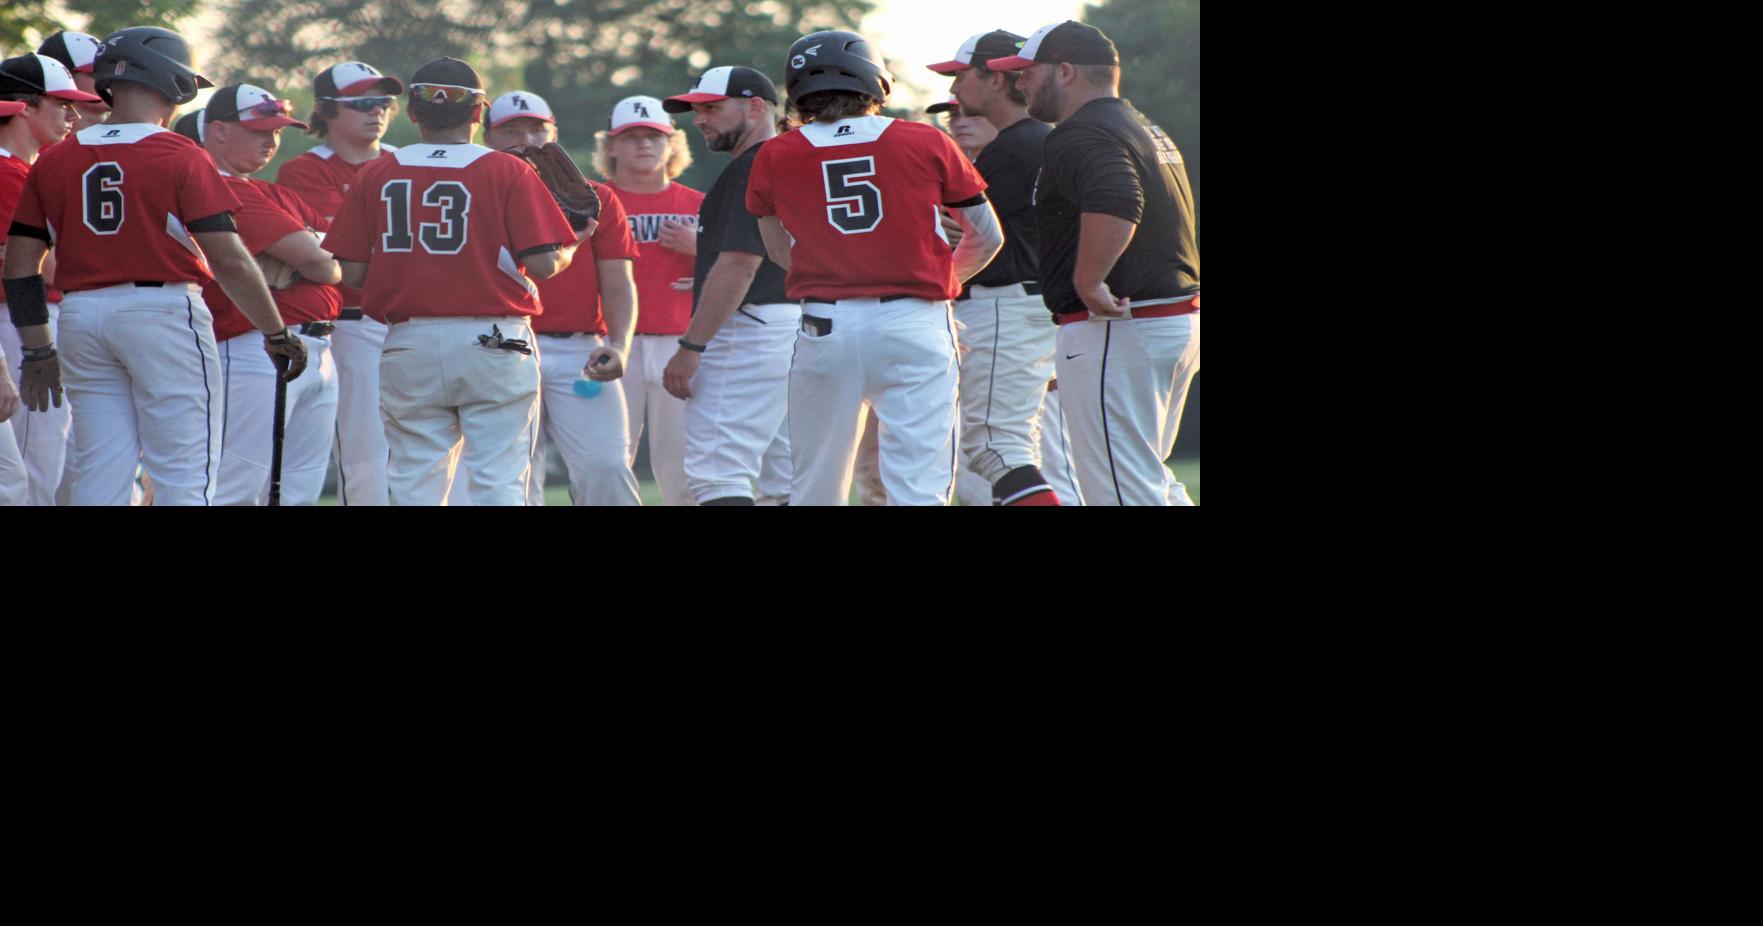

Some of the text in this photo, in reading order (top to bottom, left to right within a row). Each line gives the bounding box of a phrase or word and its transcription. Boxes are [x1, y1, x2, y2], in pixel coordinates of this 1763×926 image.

[512, 95, 529, 110] FA
[633, 102, 649, 118] FA
[82, 161, 125, 235] 6
[381, 179, 471, 254] 13
[822, 155, 883, 235] 5
